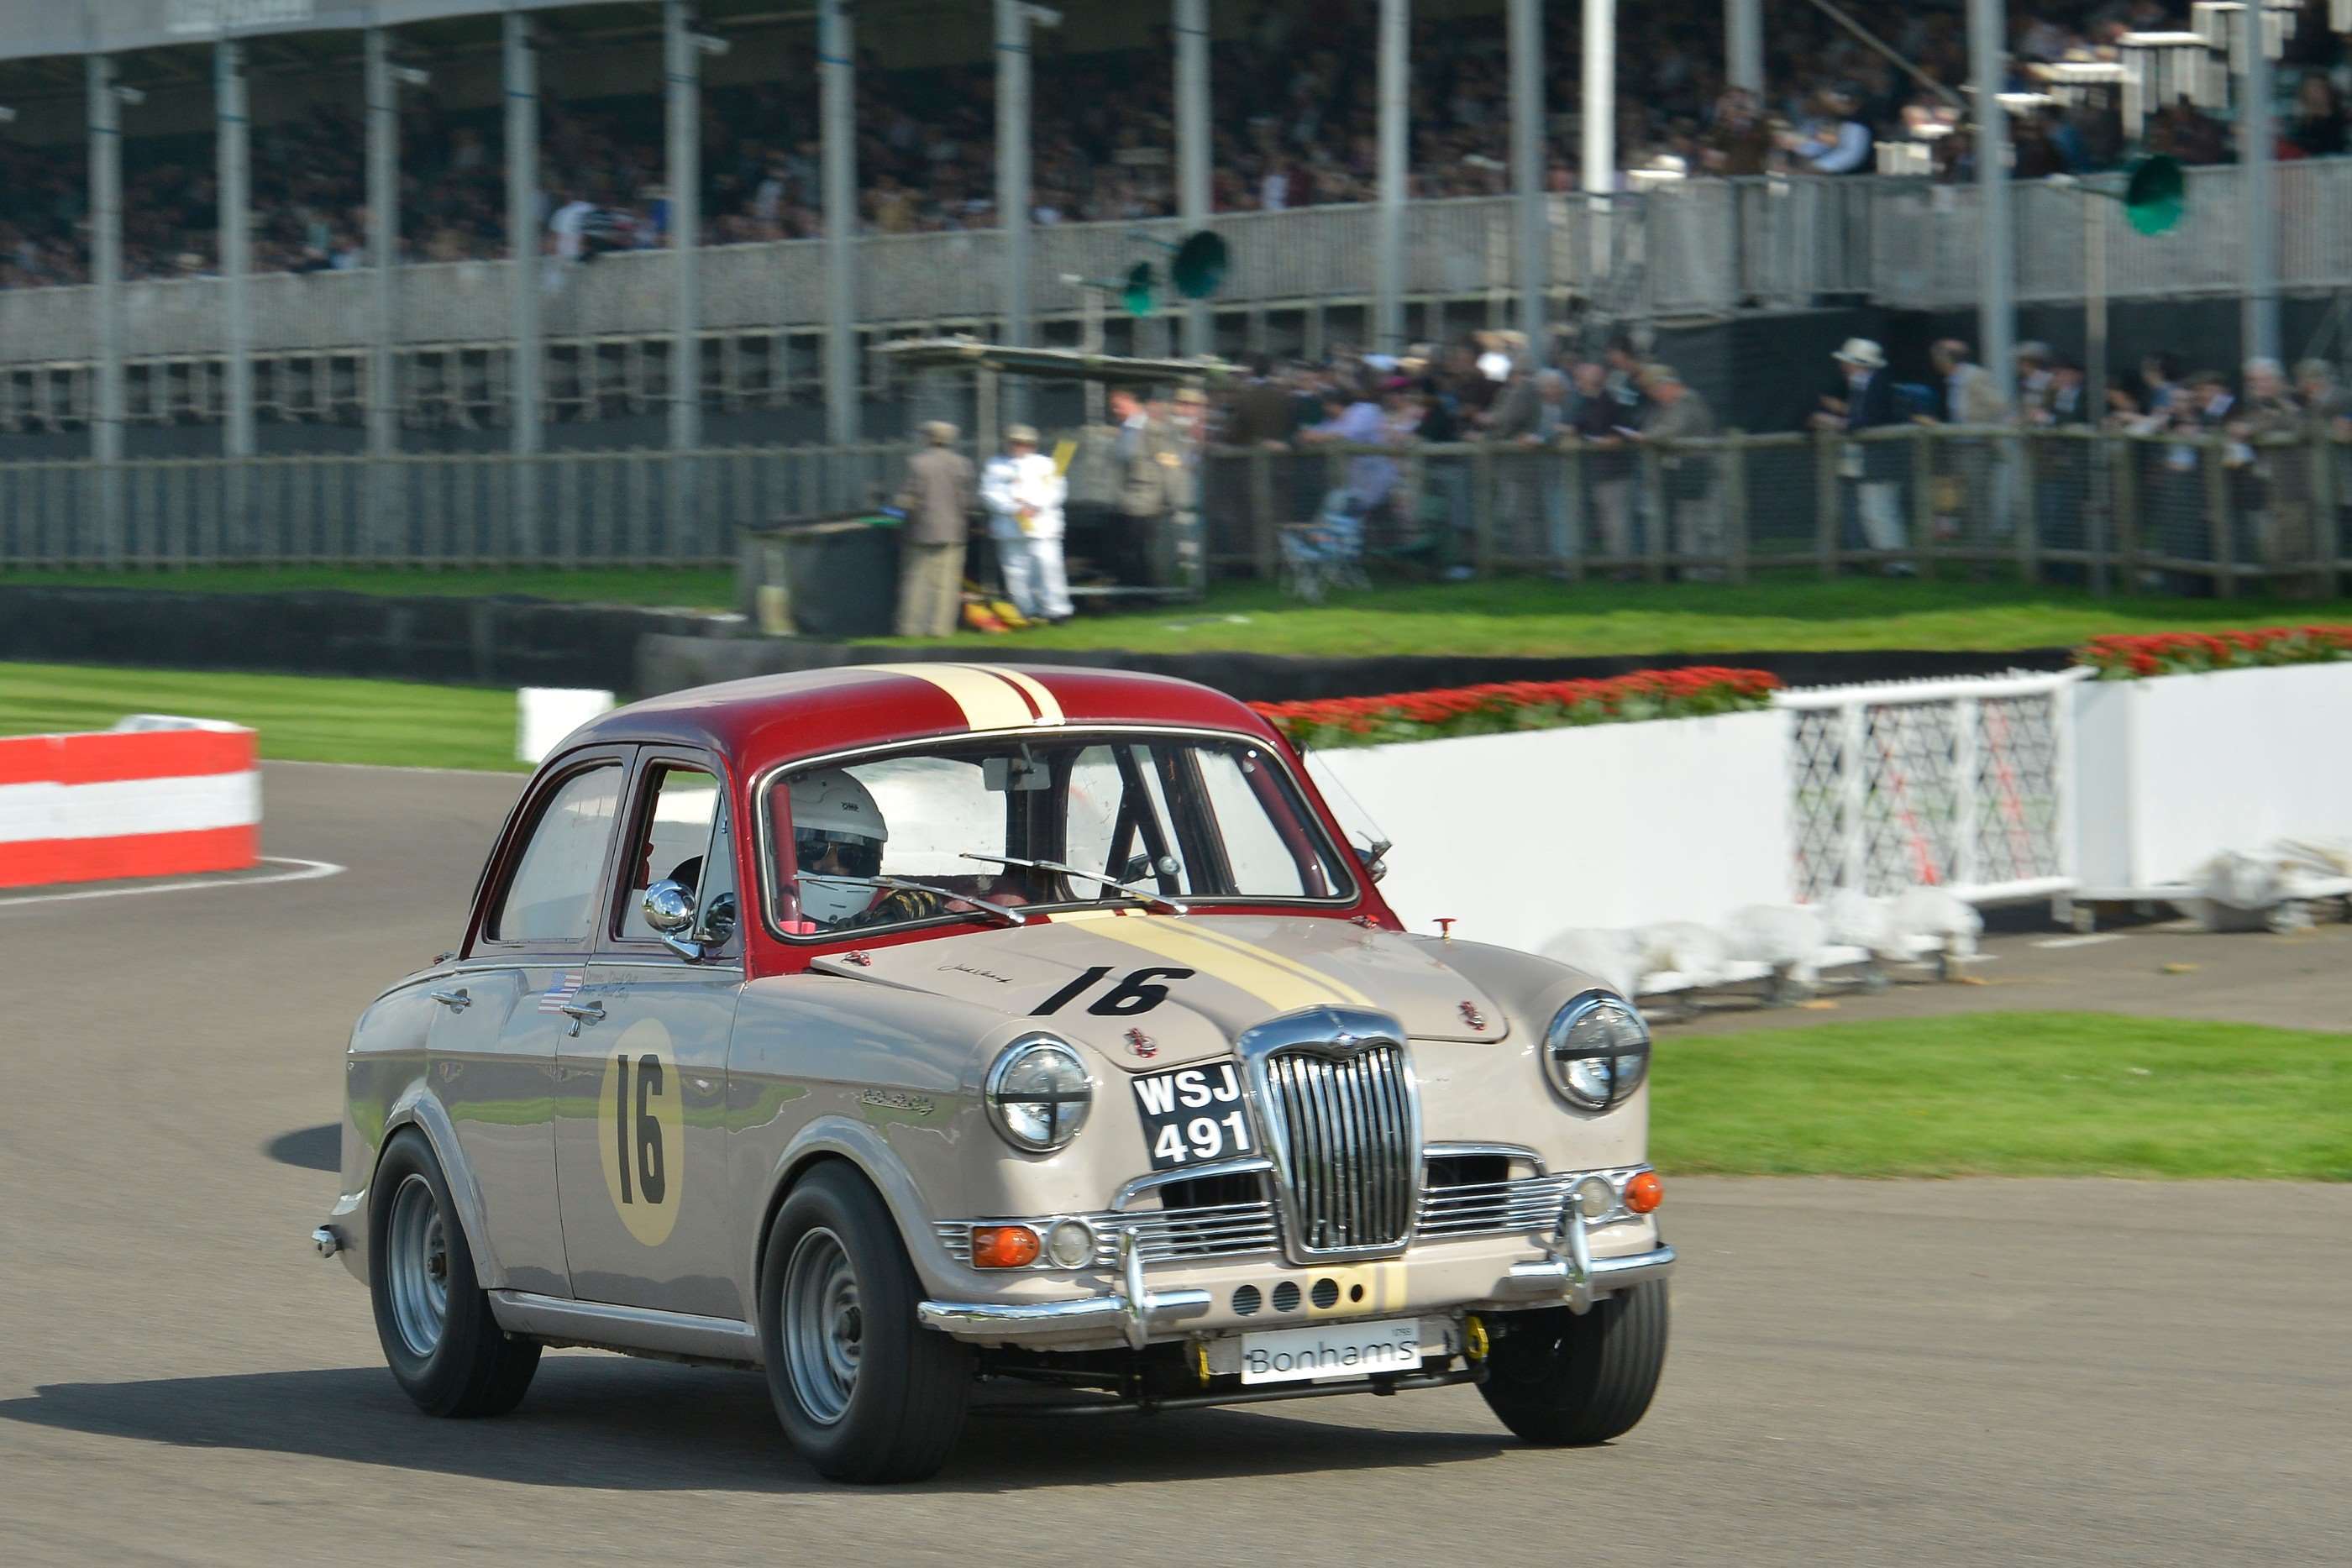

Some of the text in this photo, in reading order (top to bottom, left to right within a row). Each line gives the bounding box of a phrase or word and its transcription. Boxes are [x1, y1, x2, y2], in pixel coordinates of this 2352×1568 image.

[1027, 966, 1196, 1016] 16
[1132, 1064, 1241, 1116] WSJ
[617, 1053, 666, 1205] 16
[1154, 1110, 1251, 1163] 491
[1249, 1340, 1416, 1374] Bonhams
